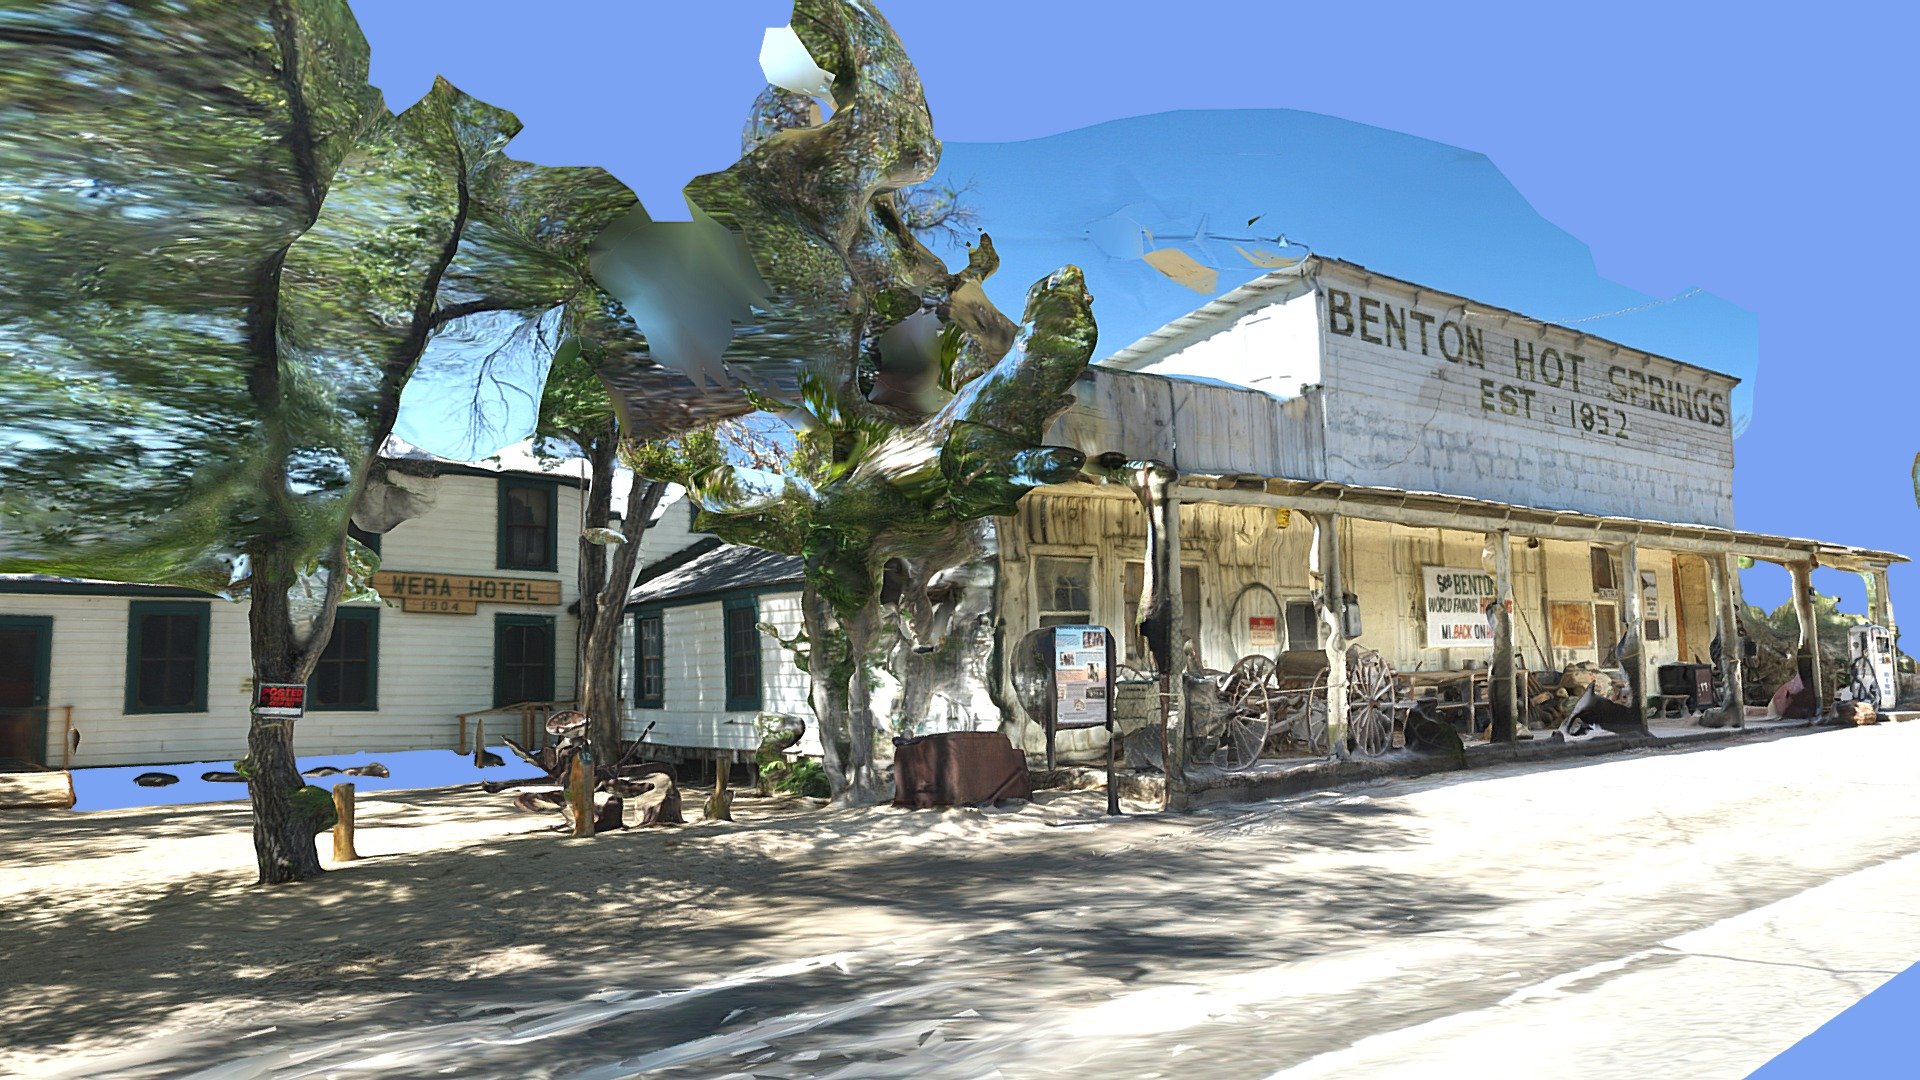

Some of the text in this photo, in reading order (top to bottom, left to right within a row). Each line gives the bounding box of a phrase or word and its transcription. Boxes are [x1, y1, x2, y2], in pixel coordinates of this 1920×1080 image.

[1327, 287, 1726, 428] BENTON HOT SPRINGS
[1570, 399, 1629, 440] 1852
[392, 575, 539, 602] WERA HOTEL
[421, 601, 460, 612] 1904
[1428, 596, 1453, 613] WORLD
[1453, 597, 1478, 614] FAMOUS
[1453, 624, 1472, 640] BACK
[1474, 624, 1486, 640] ON
[261, 687, 303, 697] POSTED
